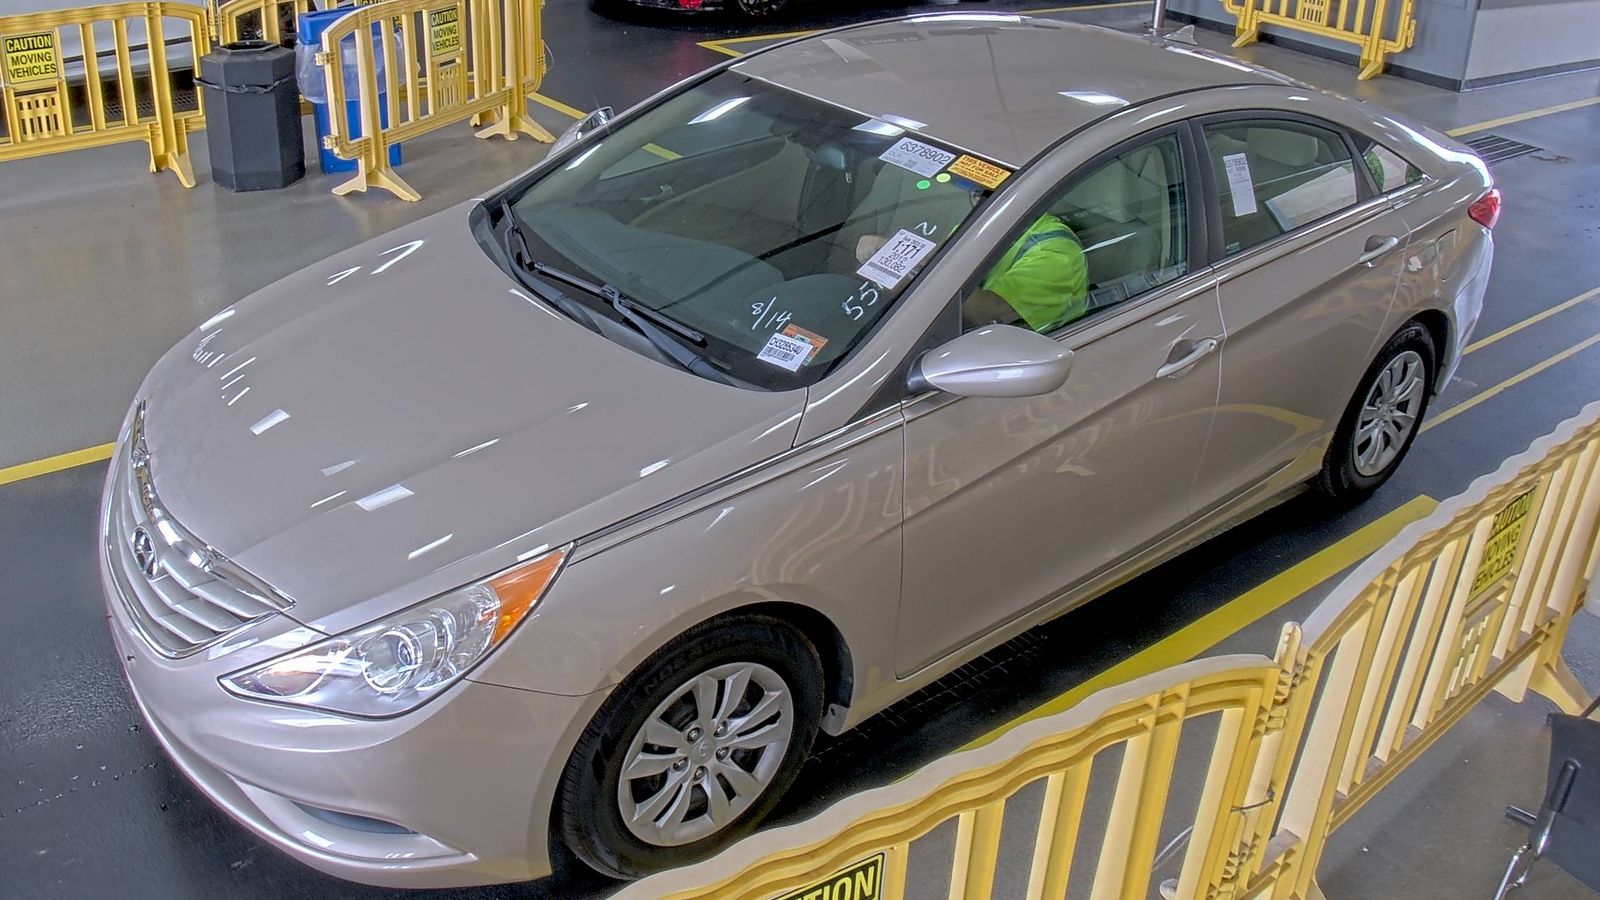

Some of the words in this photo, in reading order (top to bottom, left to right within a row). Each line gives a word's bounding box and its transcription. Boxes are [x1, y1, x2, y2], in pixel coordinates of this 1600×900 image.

[431, 10, 457, 26] CAUTION
[433, 24, 457, 39] MOVING
[7, 35, 52, 52] CAUTION
[431, 36, 459, 51] VEHICLES
[11, 52, 52, 66] MOVING
[10, 64, 57, 78] VEHICLES
[900, 141, 952, 165] 6378902
[892, 239, 922, 259] 1:171
[888, 251, 908, 264] 2012
[751, 296, 793, 331] 8/14
[1472, 546, 1517, 592] EHICLES
